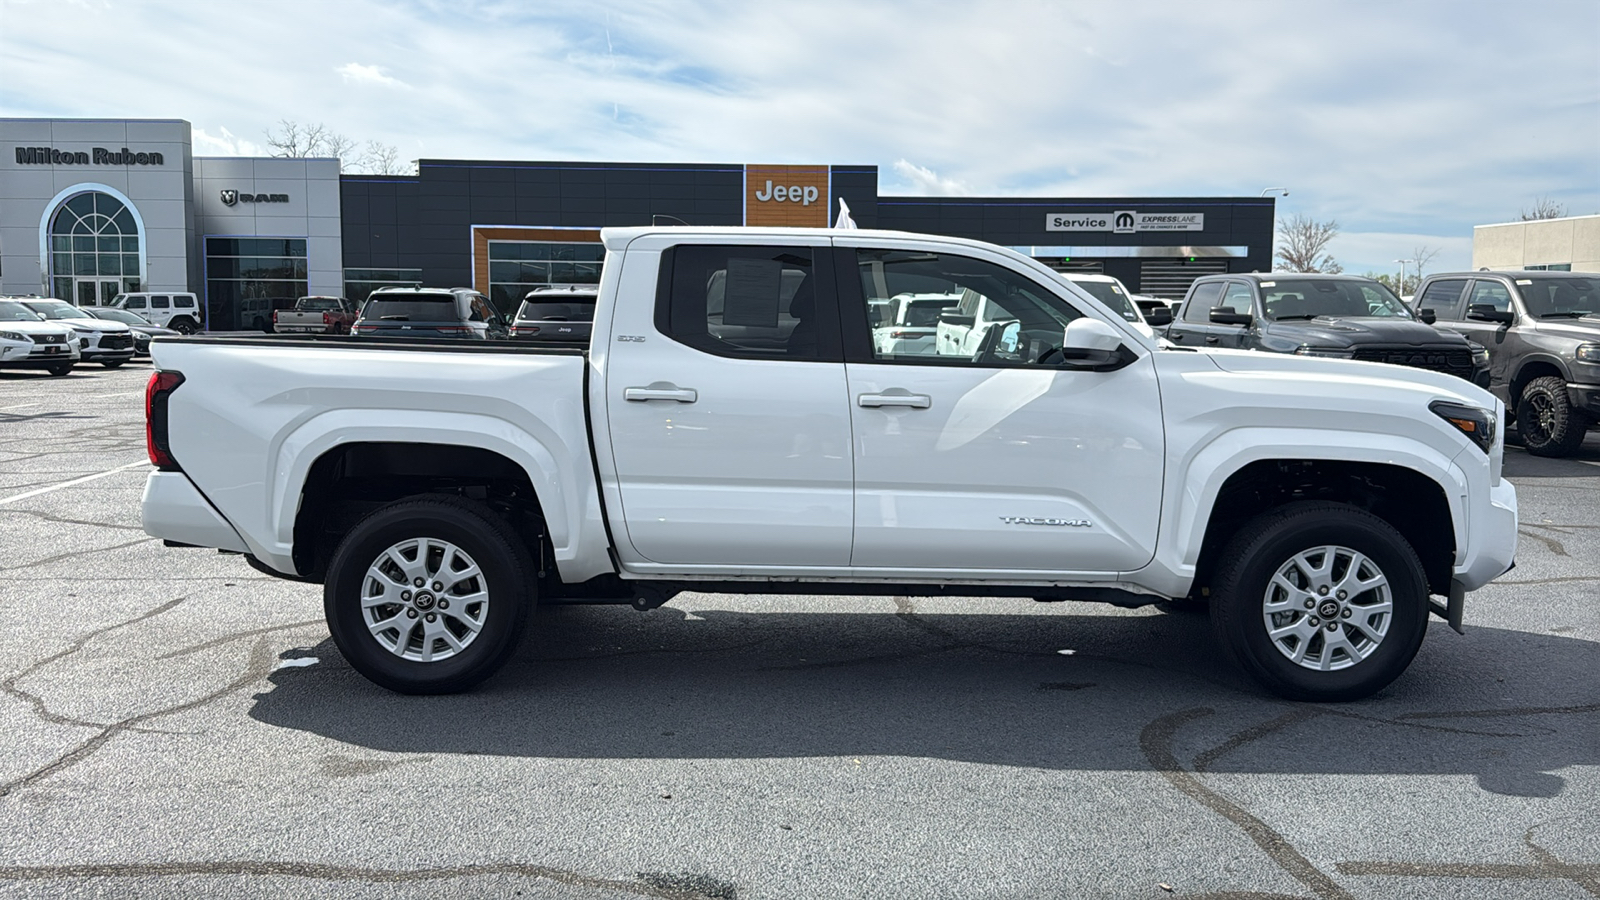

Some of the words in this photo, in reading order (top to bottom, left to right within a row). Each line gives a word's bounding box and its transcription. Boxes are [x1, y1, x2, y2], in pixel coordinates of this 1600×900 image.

[15, 147, 89, 164] Milton
[92, 147, 164, 165] Ruben
[239, 193, 289, 203] RAM
[755, 180, 819, 206] Jeep
[1053, 217, 1107, 228] Service
[1387, 354, 1446, 365] RAM
[998, 516, 1092, 527] TACOMA
